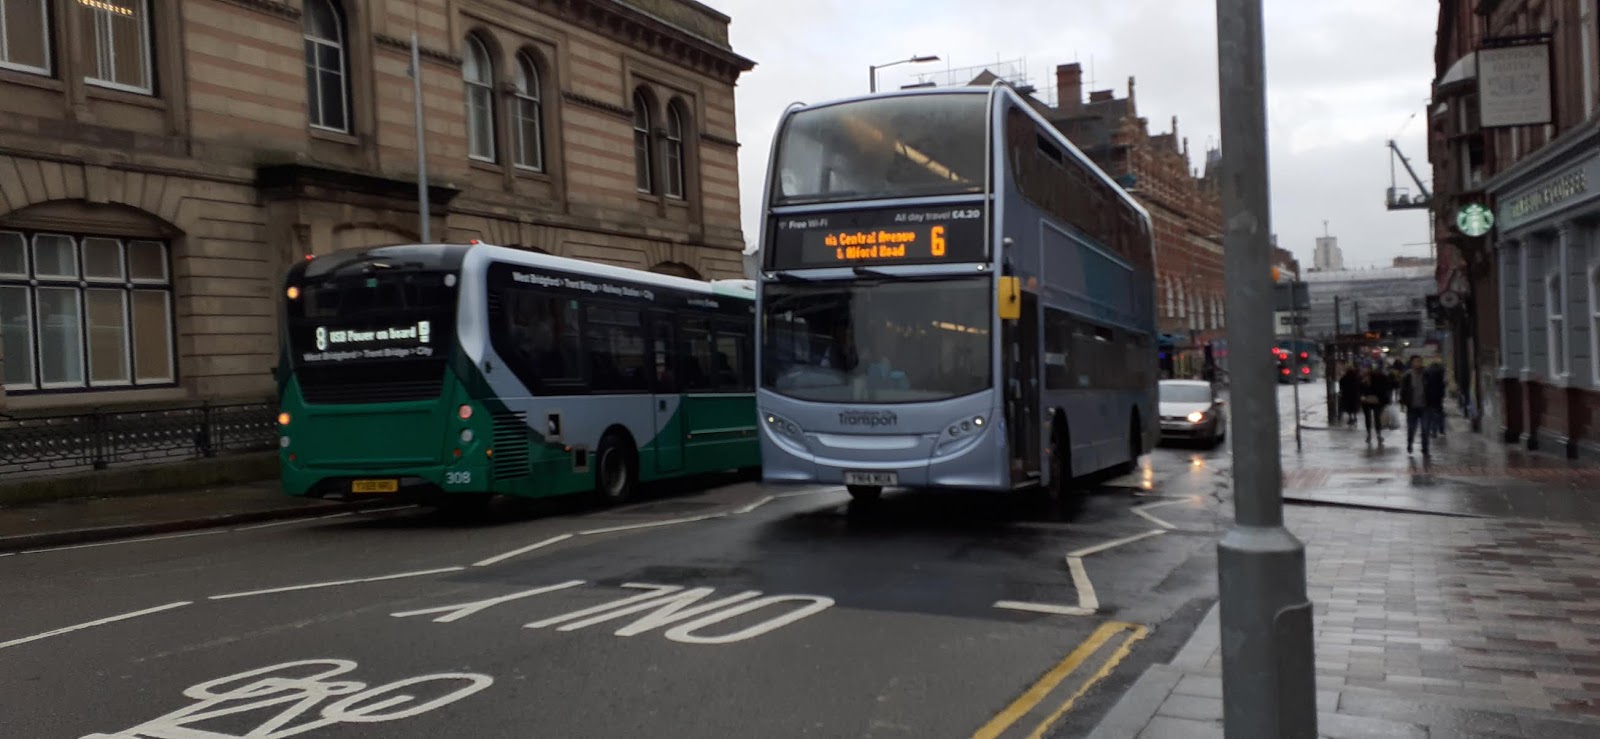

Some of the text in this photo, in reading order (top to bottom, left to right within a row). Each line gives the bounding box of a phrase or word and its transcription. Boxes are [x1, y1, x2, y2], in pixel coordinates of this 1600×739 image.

[789, 218, 828, 229] Free Wi-Fi
[894, 209, 980, 223] All day travel £4.20
[825, 230, 916, 246] via Central Avenue
[930, 225, 946, 257] 6
[879, 244, 905, 257] Road
[316, 326, 417, 350] 8 USB Power on board
[303, 353, 321, 361] West
[384, 348, 409, 358] Bridge
[415, 346, 433, 357] City
[838, 412, 897, 428] Transport
[446, 471, 471, 484] 308
[390, 579, 836, 644] ONLY
